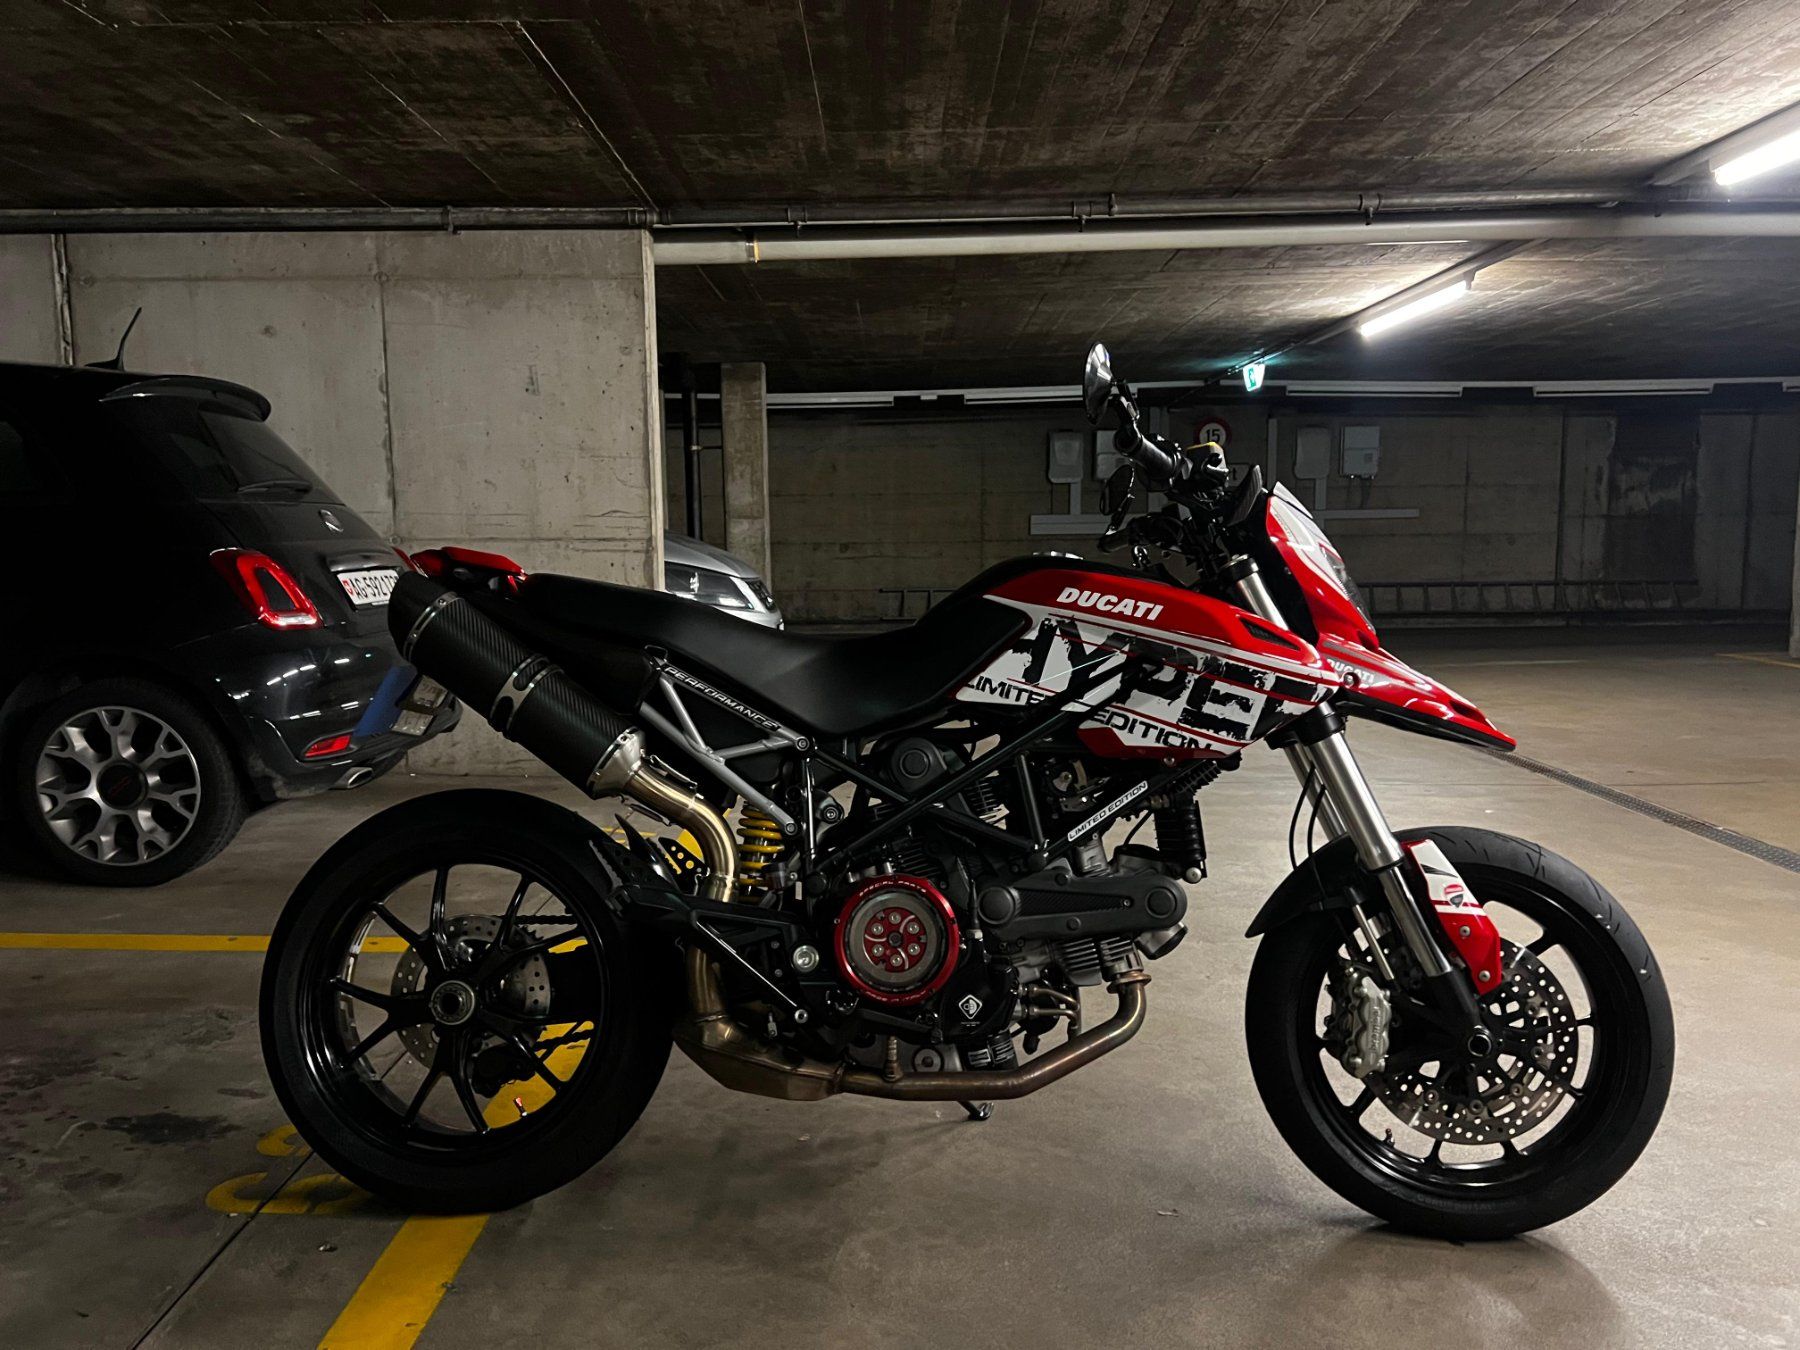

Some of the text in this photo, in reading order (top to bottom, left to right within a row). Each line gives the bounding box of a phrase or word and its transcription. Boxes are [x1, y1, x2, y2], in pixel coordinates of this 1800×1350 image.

[1206, 428, 1220, 442] 15
[1056, 587, 1164, 622] DUCATI
[664, 666, 779, 729] PERFORMANCE
[1069, 782, 1147, 839] LIMITED EDITION
